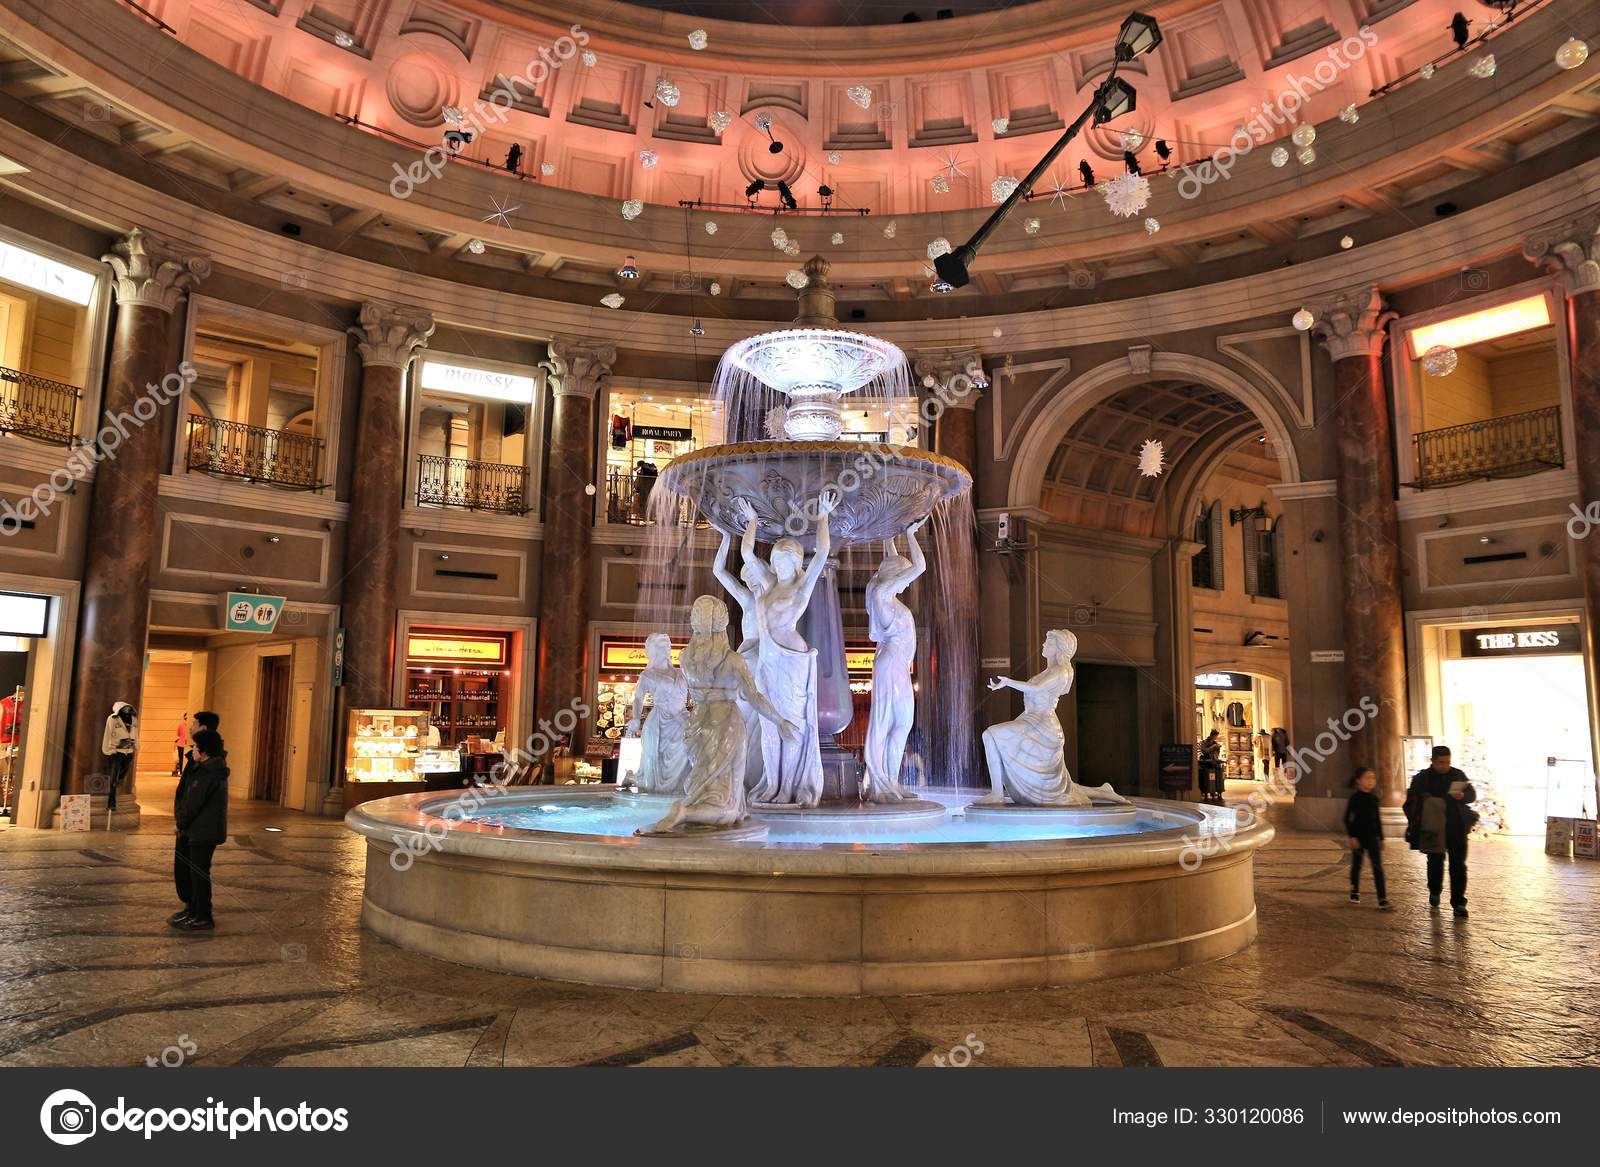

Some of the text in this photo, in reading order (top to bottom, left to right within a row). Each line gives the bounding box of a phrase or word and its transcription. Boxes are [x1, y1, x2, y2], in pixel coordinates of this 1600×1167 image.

[444, 369, 514, 390] moussy
[641, 428, 661, 436] ROYAL
[1476, 631, 1560, 649] THE KISS
[1579, 827, 1593, 835] TAX
[1577, 835, 1594, 843] FREE
